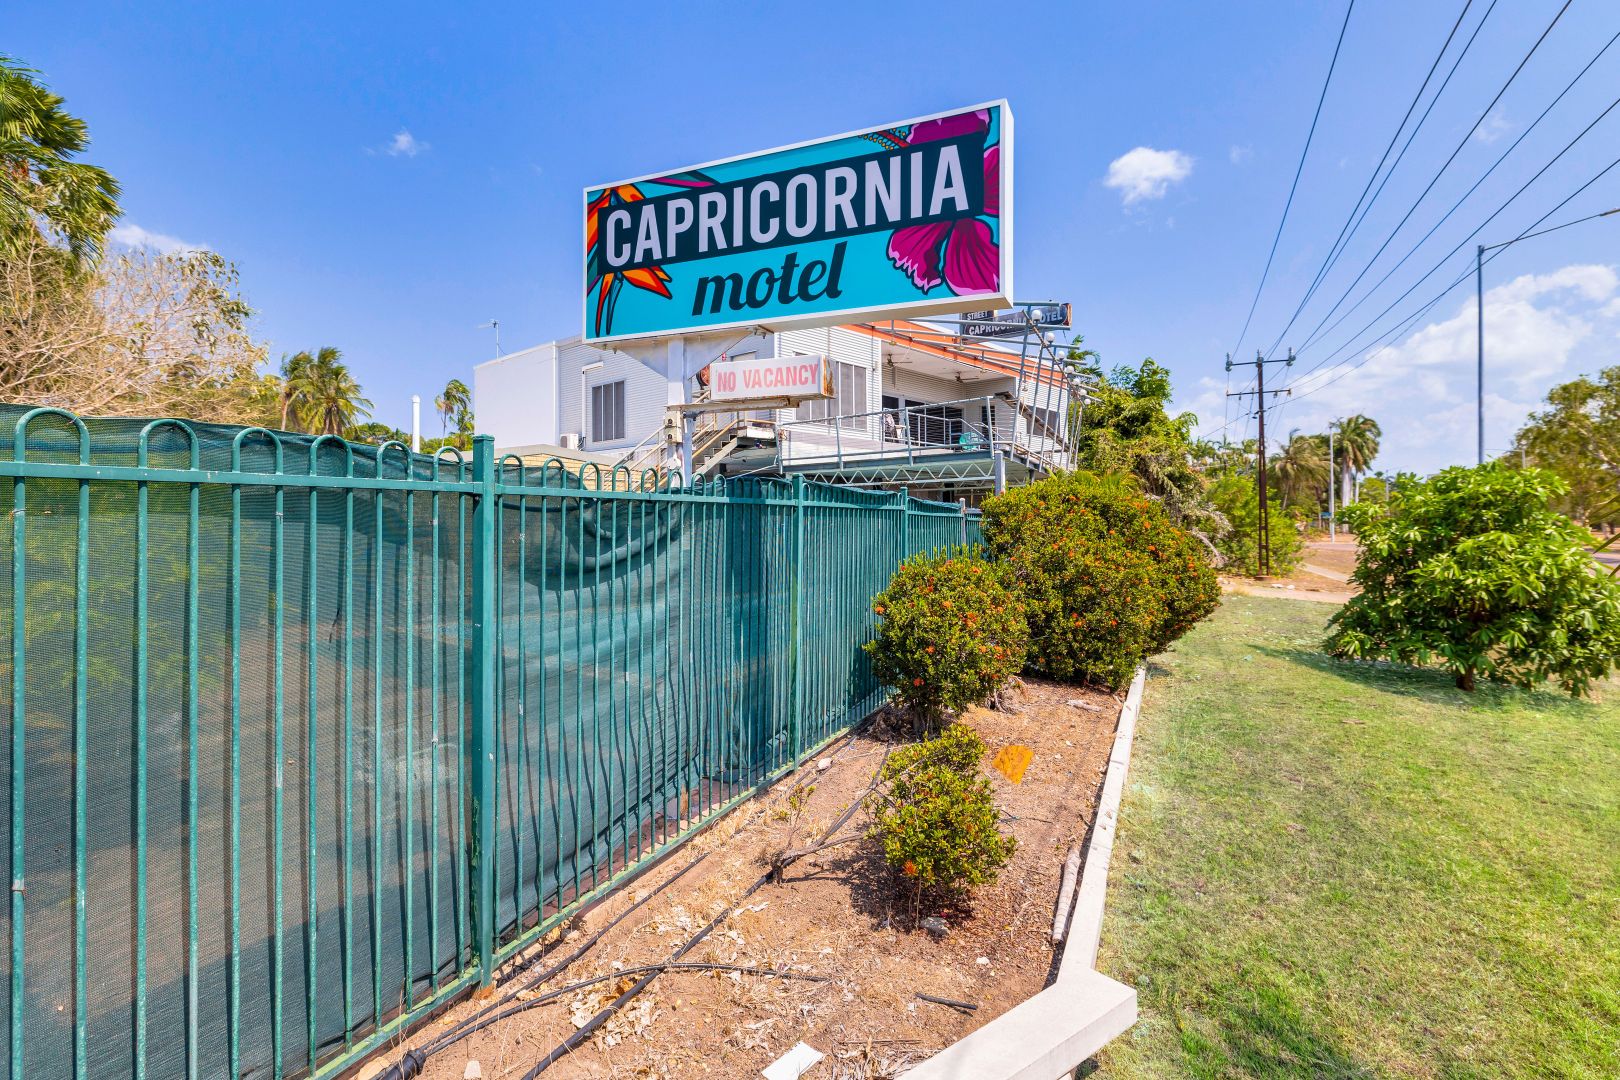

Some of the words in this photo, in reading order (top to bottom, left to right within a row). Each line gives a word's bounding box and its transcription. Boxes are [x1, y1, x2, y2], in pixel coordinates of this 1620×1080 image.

[606, 144, 969, 268] CAPRICORNIA
[692, 241, 848, 316] motel
[967, 311, 988, 320] STREET
[1033, 308, 1063, 324] OTEL
[717, 371, 737, 393] NO
[743, 363, 819, 389] VACANCY
